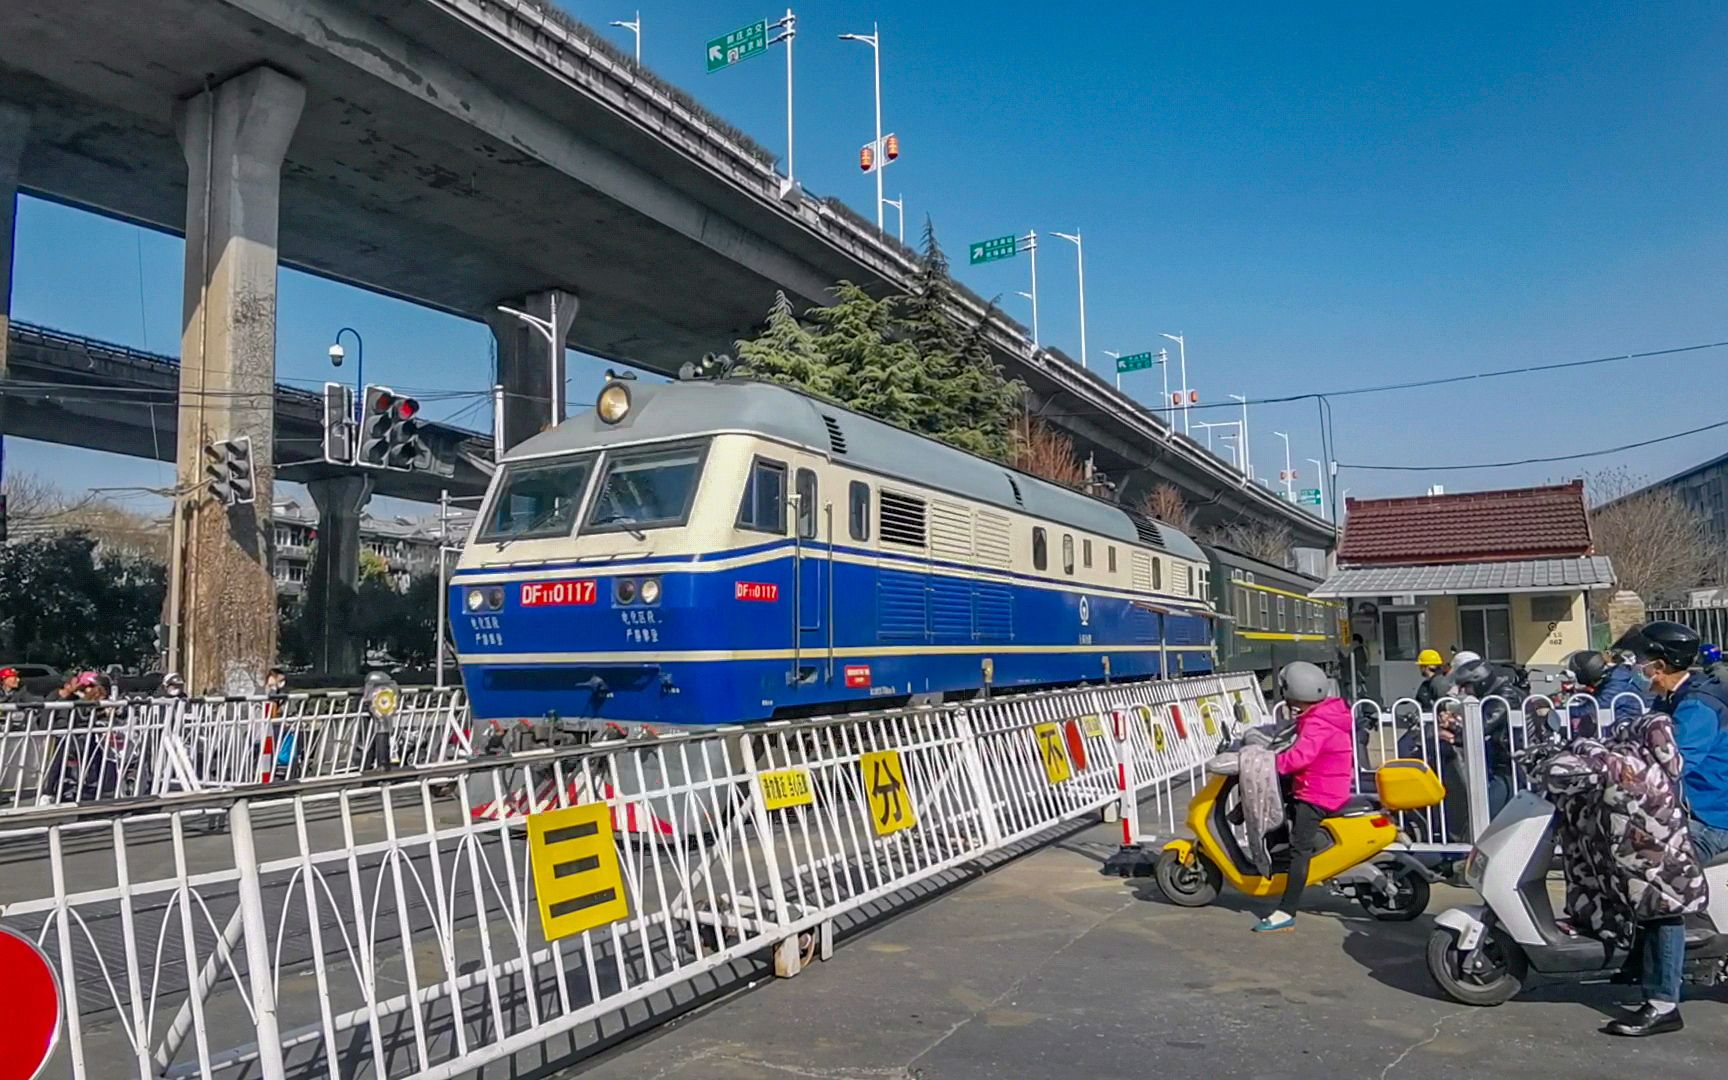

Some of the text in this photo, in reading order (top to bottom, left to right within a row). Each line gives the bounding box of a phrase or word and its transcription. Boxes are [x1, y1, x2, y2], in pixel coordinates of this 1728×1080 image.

[1040, 730, 1063, 774] 不
[872, 757, 902, 825] 分
[544, 820, 616, 919] 三
